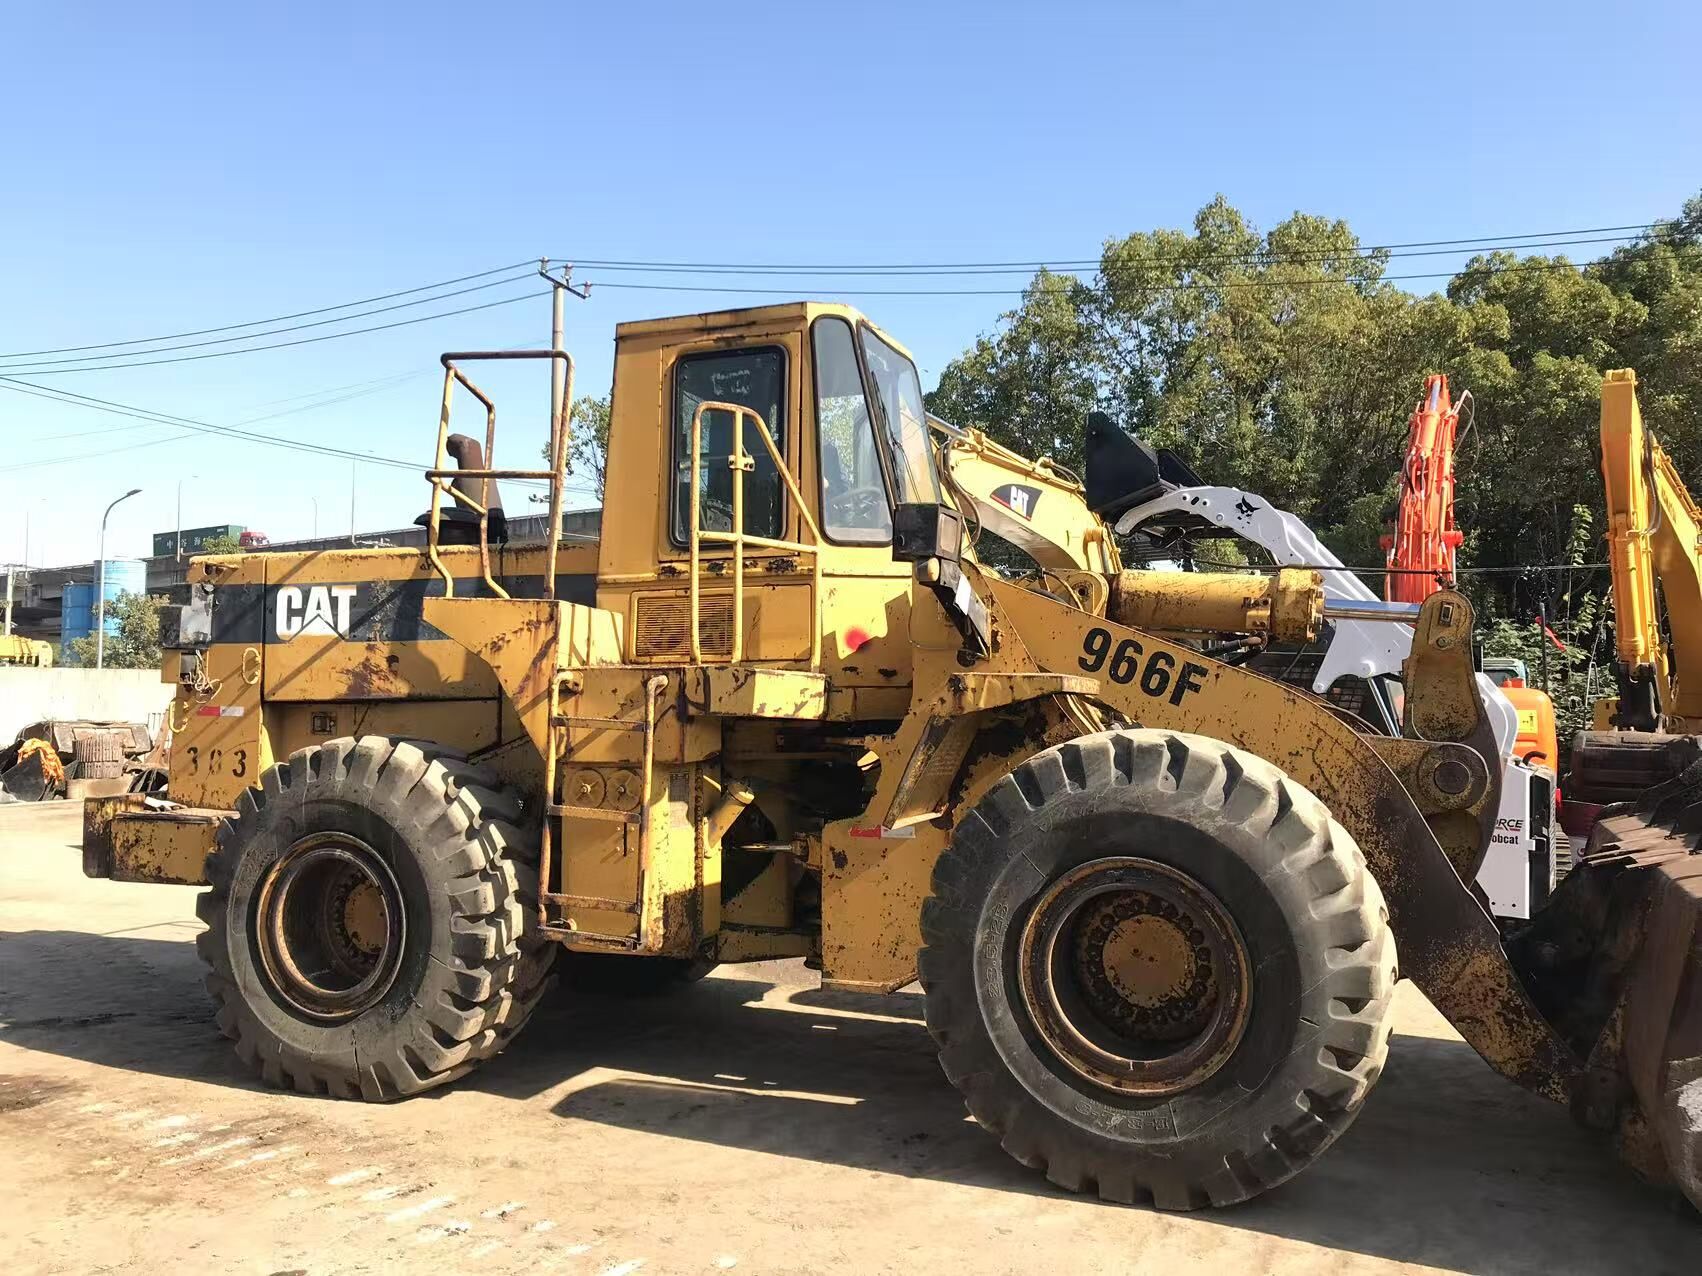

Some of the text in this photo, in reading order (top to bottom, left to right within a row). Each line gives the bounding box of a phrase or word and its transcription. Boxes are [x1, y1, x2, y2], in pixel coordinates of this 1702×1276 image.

[1009, 485, 1029, 517] CAT
[276, 585, 357, 641] CAT
[1077, 627, 1209, 707] 966F
[1491, 834, 1519, 845] obcat
[1496, 818, 1524, 831] RCE
